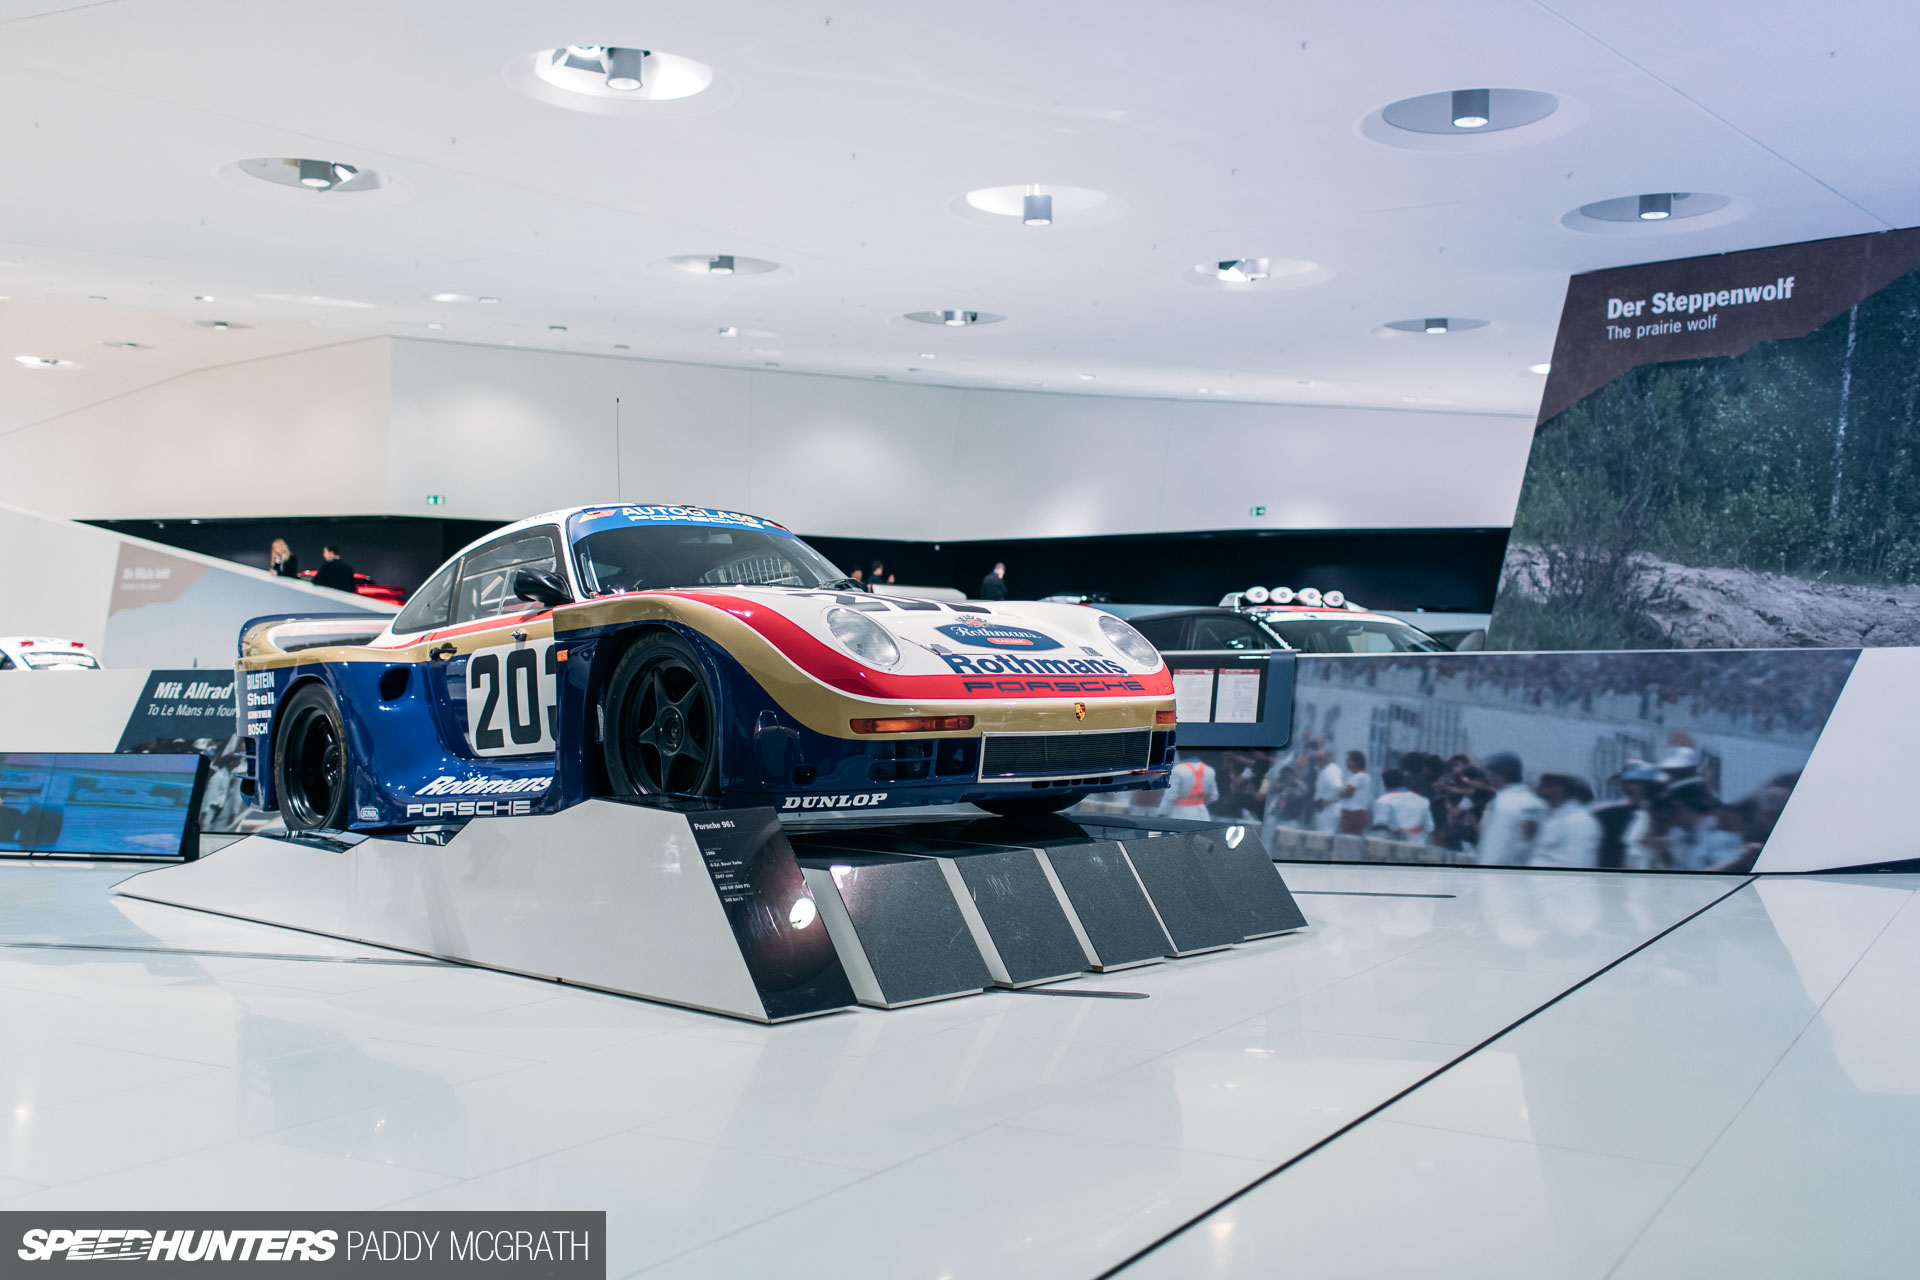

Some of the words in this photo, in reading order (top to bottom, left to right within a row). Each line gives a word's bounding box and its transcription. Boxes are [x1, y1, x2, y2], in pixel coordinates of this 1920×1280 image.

[1607, 298, 1646, 319] Der
[1651, 276, 1795, 315] Steppenwolf
[1607, 325, 1631, 340] The
[1636, 320, 1682, 339] prairie
[1687, 314, 1718, 331] wolf
[622, 506, 759, 524] AUTOGLASS
[630, 515, 765, 530] PORSCHE
[950, 624, 1042, 639] Rothmans
[940, 654, 1128, 676] Rothmans
[247, 671, 275, 690] BILSTEIN
[963, 681, 1146, 693] PORSCHE
[153, 682, 183, 699] Mit
[183, 682, 234, 699] Allrad
[247, 692, 275, 706] Shell
[148, 703, 160, 716] To
[161, 704, 174, 716] Le
[176, 704, 203, 716] Mans
[204, 704, 215, 716] in
[248, 722, 268, 736] BOSCH
[415, 775, 553, 796] Rothmans
[406, 800, 531, 817] PORSCHE
[782, 793, 888, 809] DUNLOP
[694, 822, 721, 830] Porsche
[721, 820, 736, 829] 961
